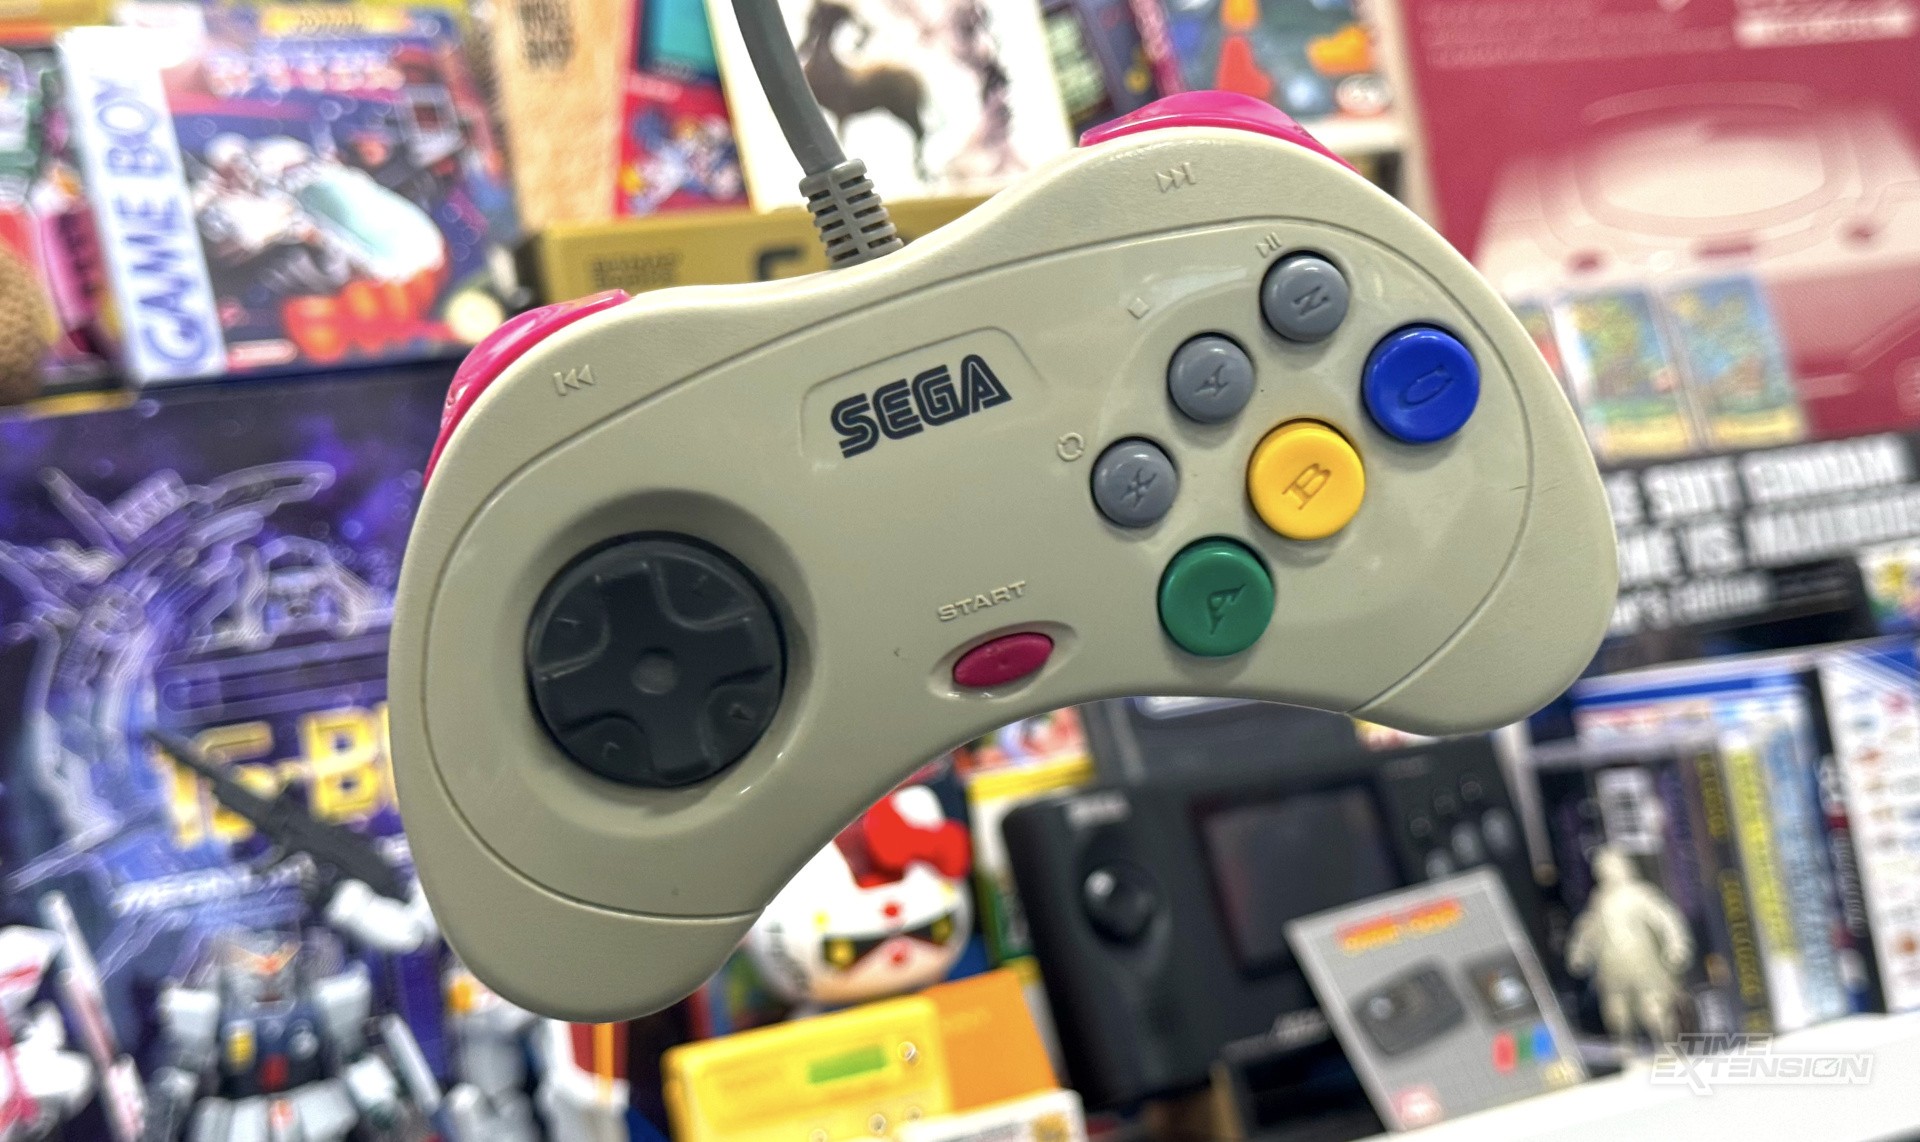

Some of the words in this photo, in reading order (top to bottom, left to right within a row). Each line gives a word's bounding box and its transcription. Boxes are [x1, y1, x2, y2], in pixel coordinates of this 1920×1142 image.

[113, 195, 211, 366] GAME
[1195, 364, 1229, 397] Y
[1404, 364, 1453, 406] C
[831, 354, 1013, 459] SEGA
[1121, 467, 1156, 508] X
[1281, 462, 1332, 511] B
[937, 581, 1027, 622] START
[1206, 583, 1247, 635] A
